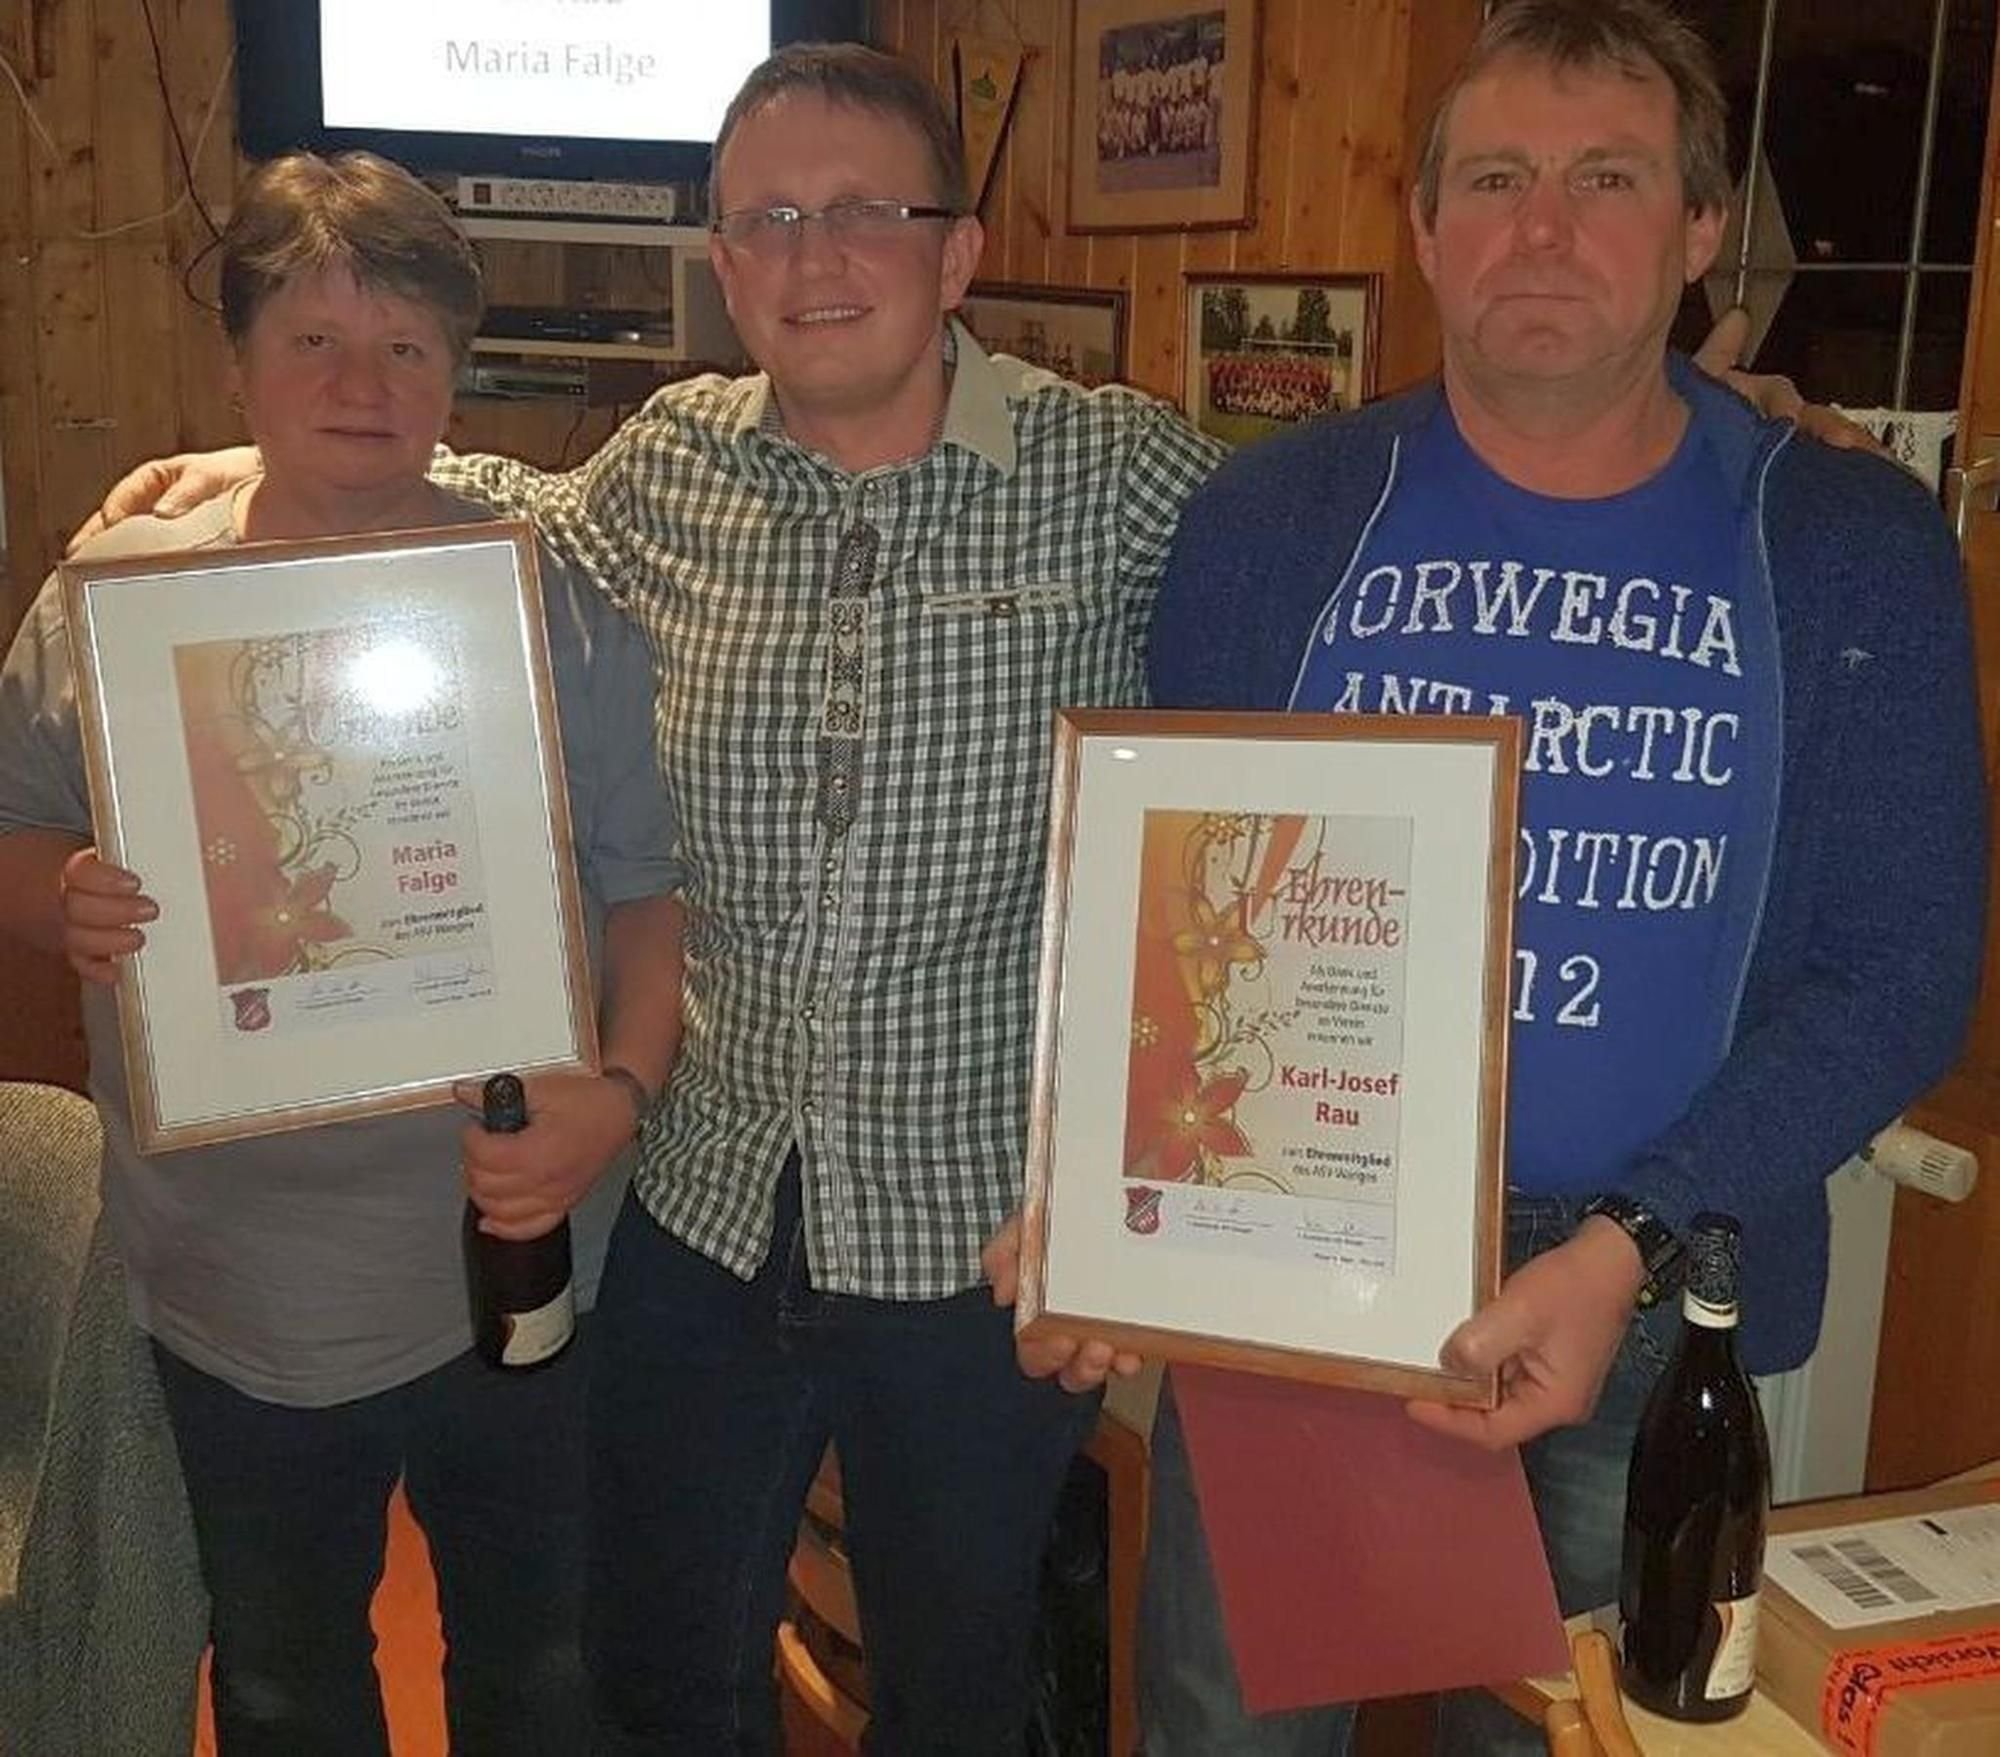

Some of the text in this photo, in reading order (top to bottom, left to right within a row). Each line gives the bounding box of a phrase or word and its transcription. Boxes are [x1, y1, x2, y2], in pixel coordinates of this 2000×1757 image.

[446, 40, 656, 84] Maria Falge
[1323, 560, 1742, 677] ORWEGIA
[1333, 671, 1739, 786] ANRCTIC
[393, 840, 457, 864] Maria
[399, 871, 457, 894] Falge
[1281, 1066, 1399, 1096] Karl-Josef
[1315, 1102, 1359, 1126] Rau
